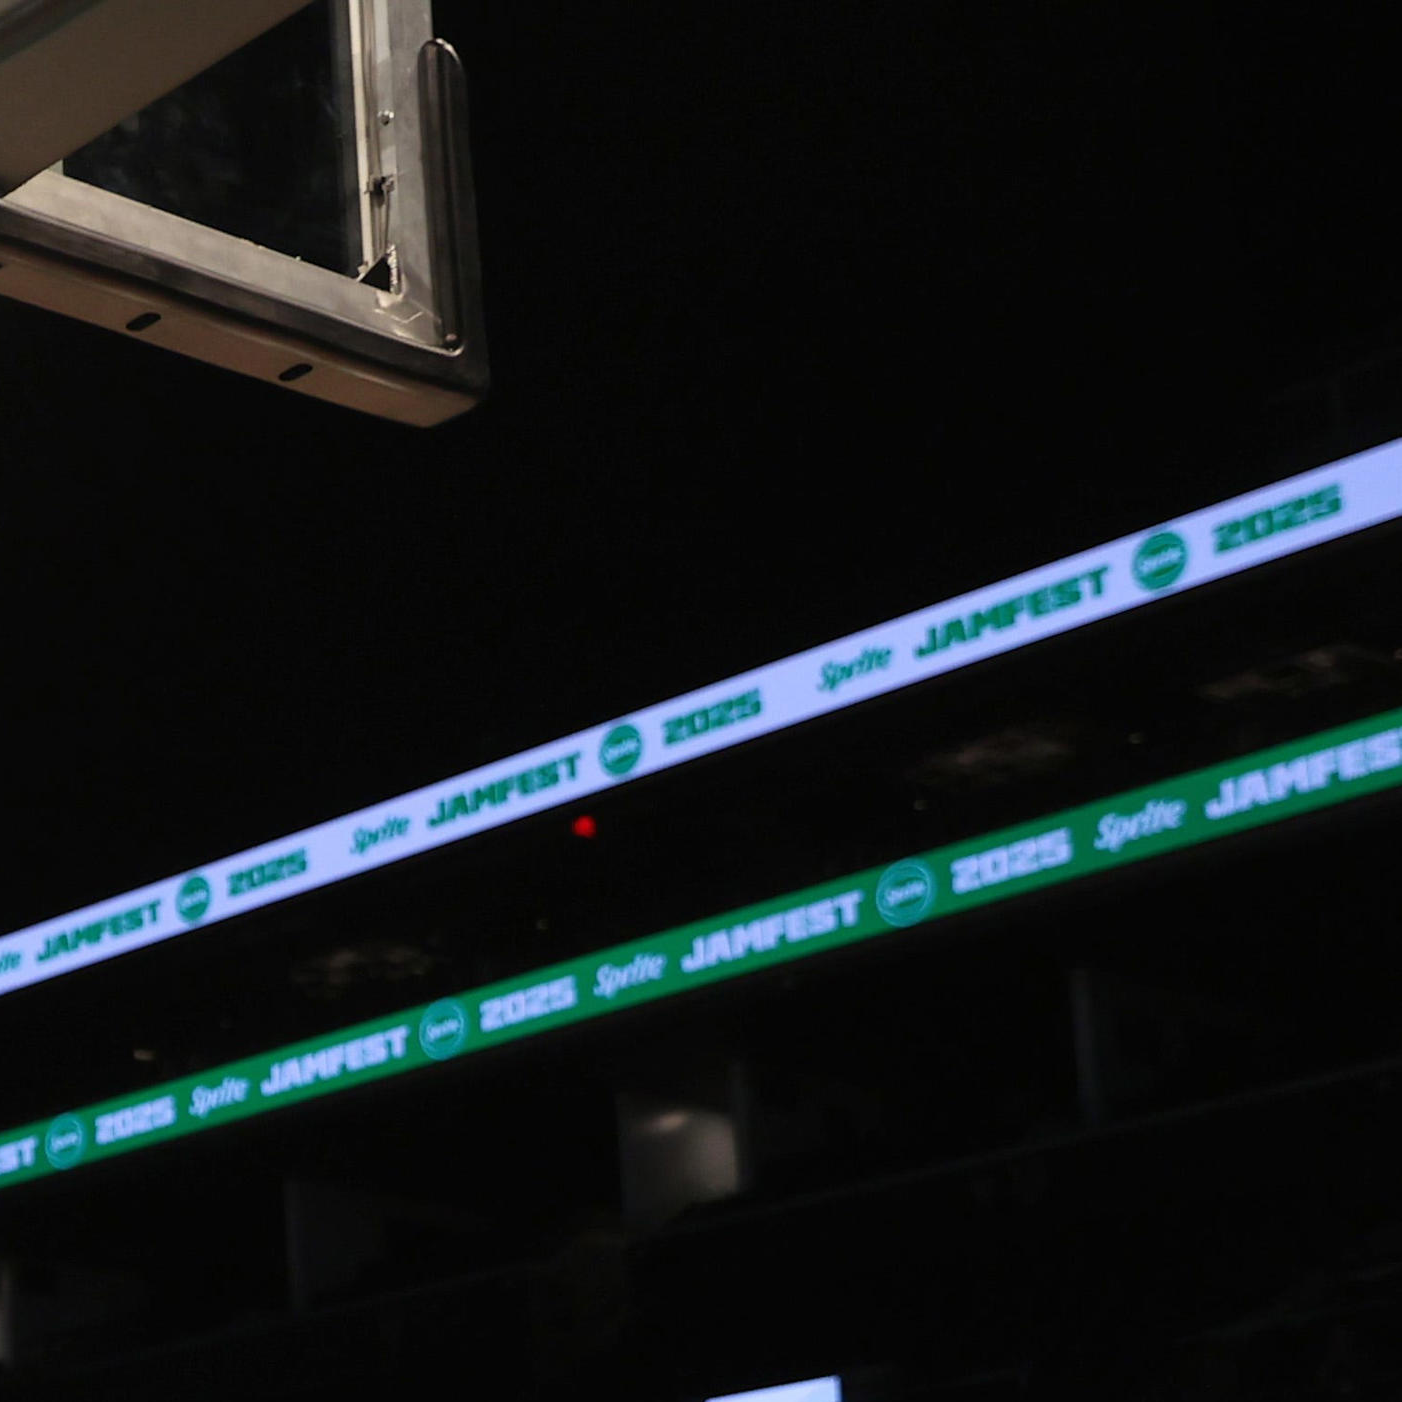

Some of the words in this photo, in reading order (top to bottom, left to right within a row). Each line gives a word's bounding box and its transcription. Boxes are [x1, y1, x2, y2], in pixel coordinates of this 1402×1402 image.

[818, 645, 895, 693] Sprite
[913, 564, 1112, 660] JAMFEST
[1212, 483, 1346, 556] 2025
[350, 816, 412, 857] Sprite
[426, 752, 583, 828] JAMFEST
[662, 688, 764, 747] 2025
[35, 899, 162, 963] JAMFEST
[226, 850, 310, 897] 2025
[95, 1095, 177, 1145] 2025
[190, 1078, 249, 1118] Sprite
[260, 1025, 409, 1096] JAMFEST
[479, 976, 577, 1032] 2025
[594, 954, 667, 997] Sprite
[681, 890, 862, 972] JAMFEST
[951, 828, 1072, 893] 2025
[1095, 800, 1186, 851] Sprite
[1204, 727, 1402, 819] JAMFES
